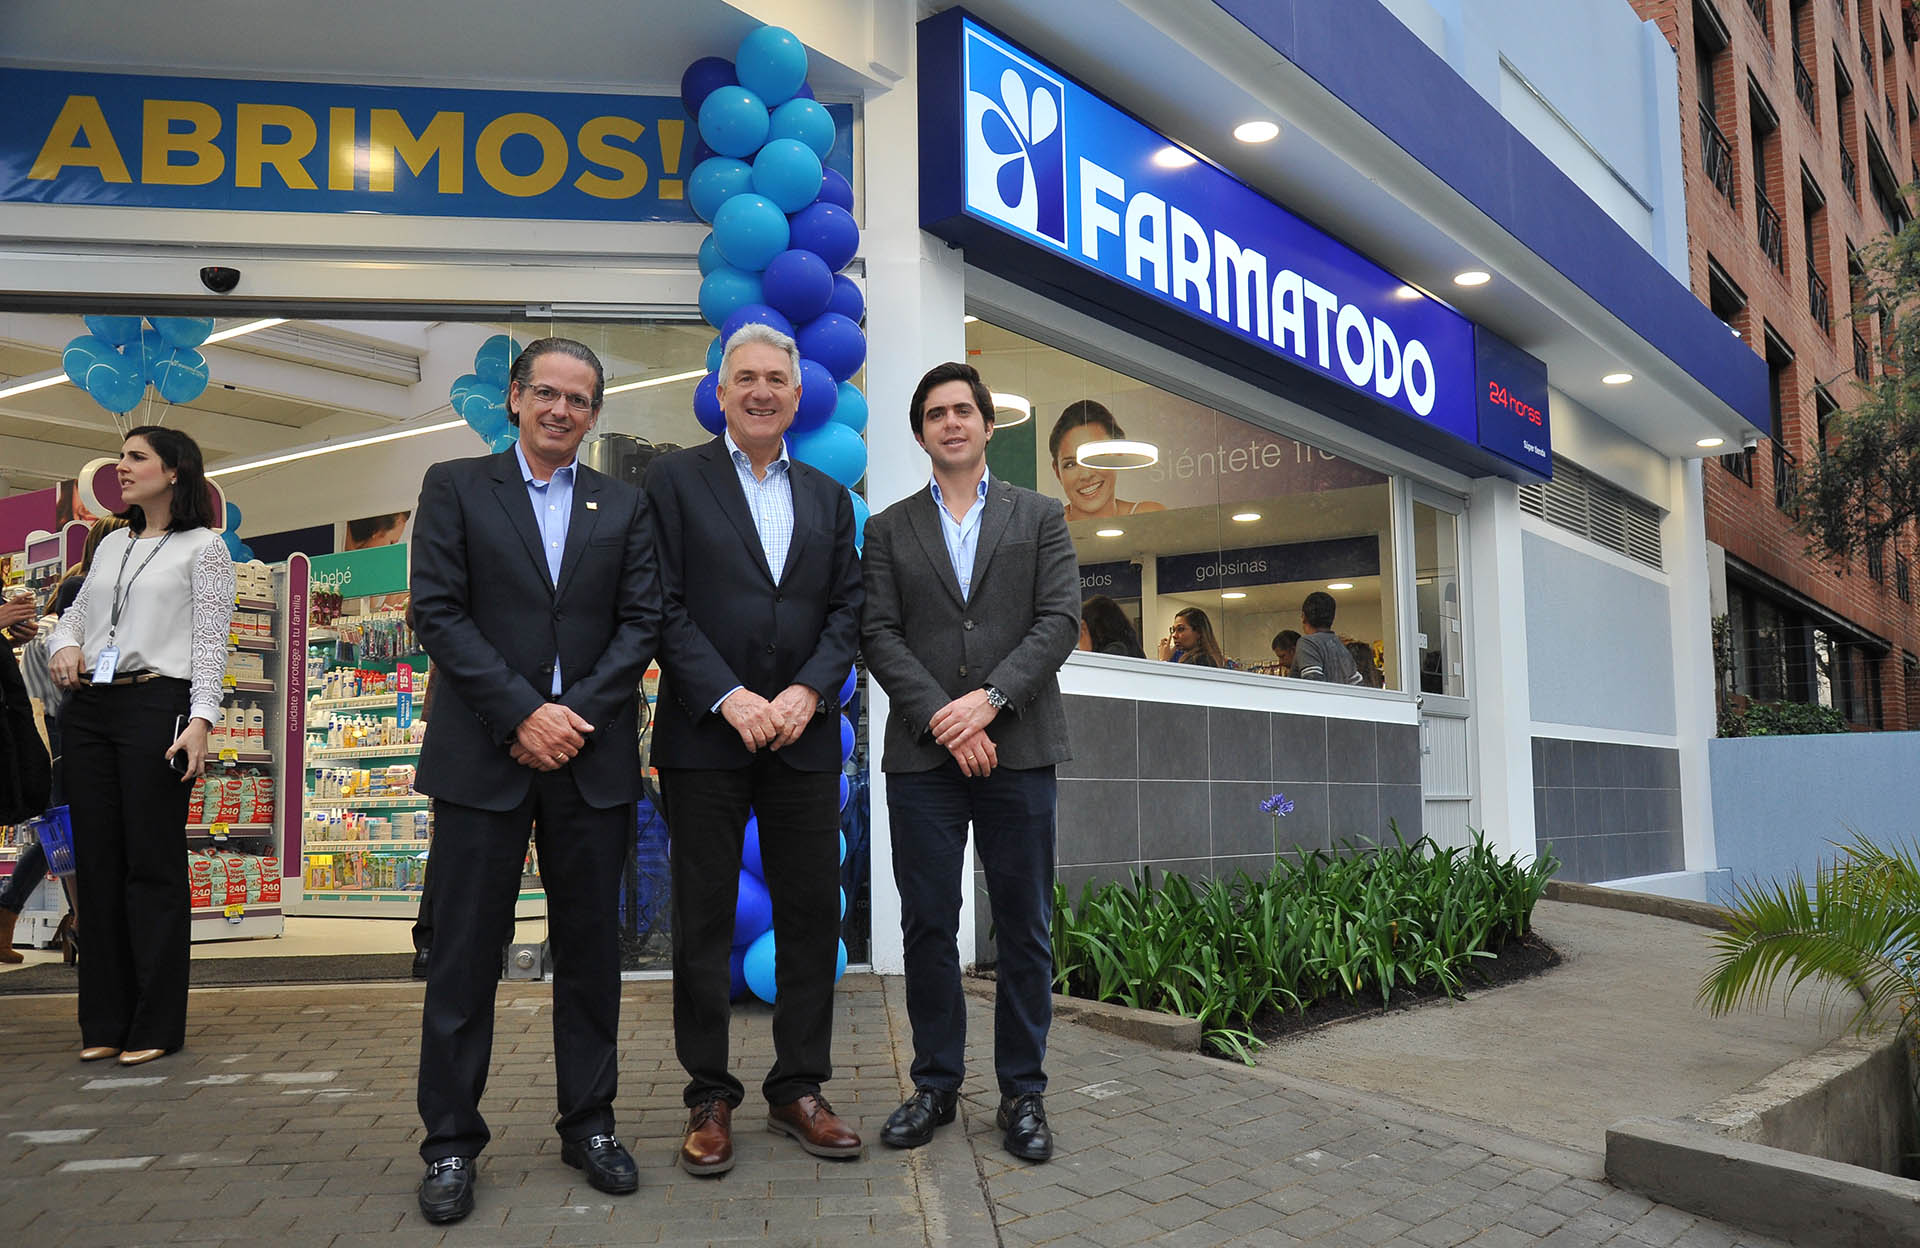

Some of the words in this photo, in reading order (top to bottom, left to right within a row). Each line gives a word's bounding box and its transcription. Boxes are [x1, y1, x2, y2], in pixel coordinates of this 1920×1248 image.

[27, 95, 685, 200] ABRIMOS!
[1079, 156, 1436, 417] FARMATODO
[1489, 381, 1508, 408] 24
[1150, 440, 1281, 482] siéntete
[320, 566, 352, 586] bebé
[1079, 572, 1112, 588] ados
[1195, 559, 1267, 581] golosinas
[292, 594, 301, 626] familia
[292, 628, 300, 638] tu
[291, 648, 301, 686] protege
[221, 807, 239, 815] 240
[192, 888, 211, 897] 240
[229, 884, 246, 892] 240
[263, 883, 280, 891] 240
